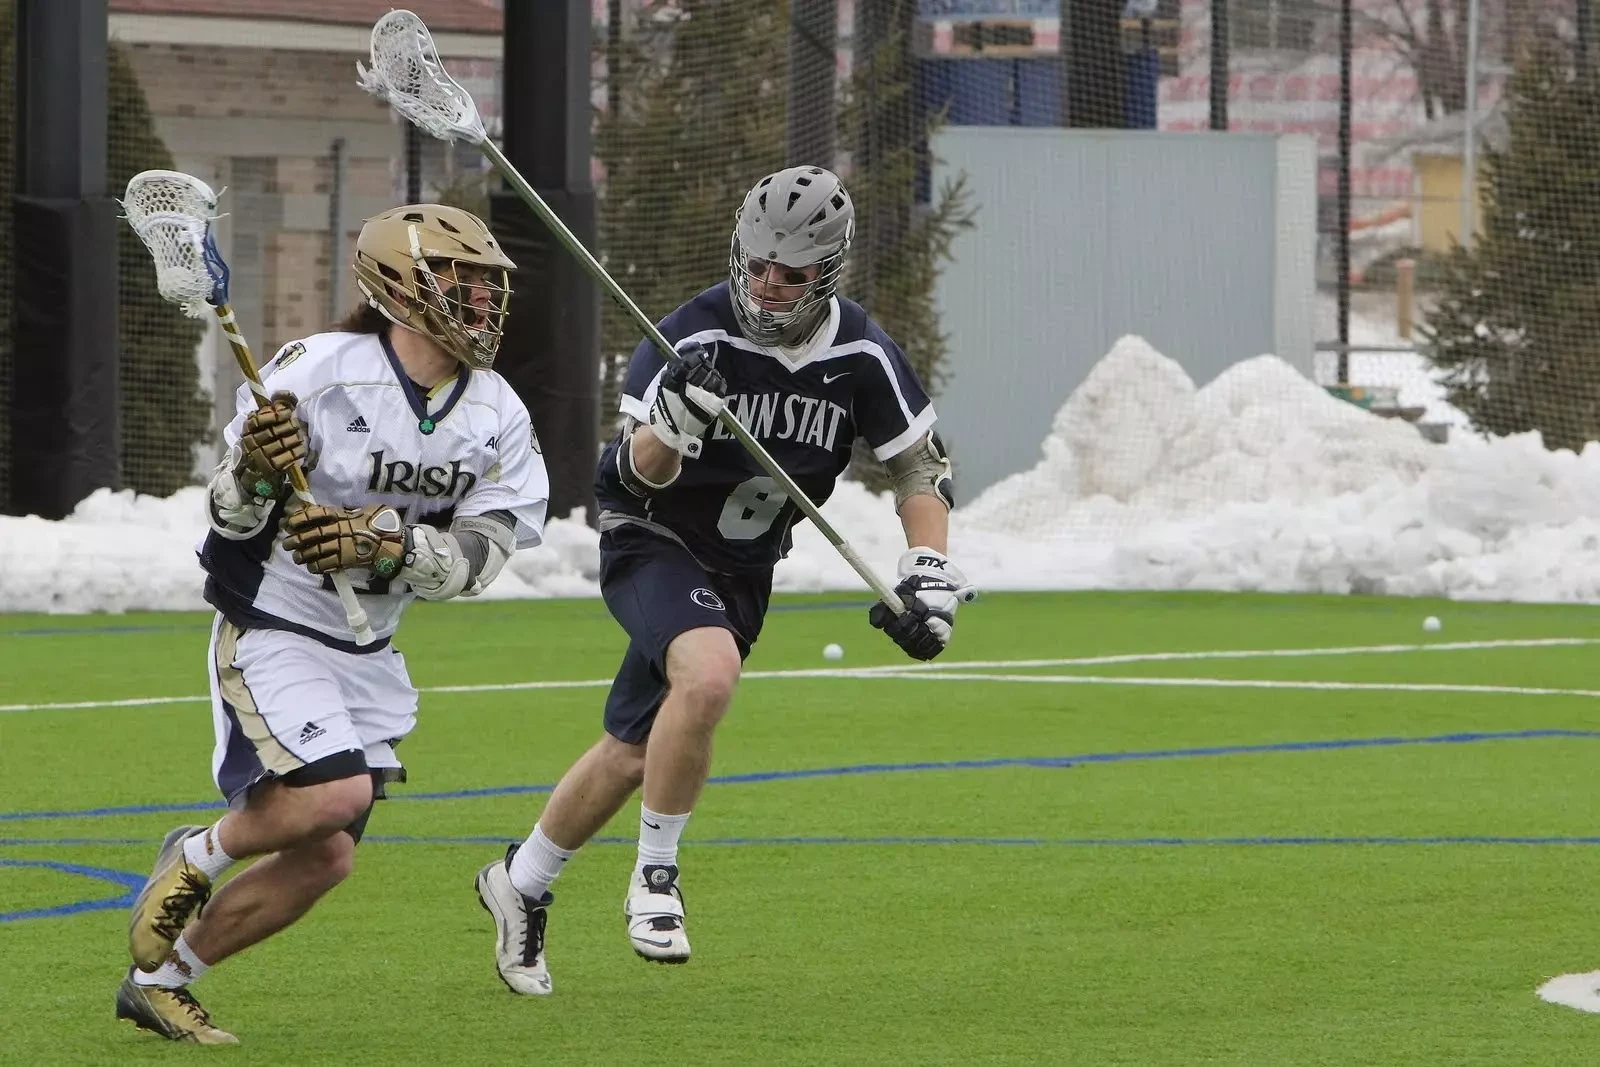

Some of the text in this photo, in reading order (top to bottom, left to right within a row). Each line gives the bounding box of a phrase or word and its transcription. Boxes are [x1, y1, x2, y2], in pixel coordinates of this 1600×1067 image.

[703, 392, 780, 440] ENN
[716, 475, 789, 540] 8
[914, 555, 948, 571] STX
